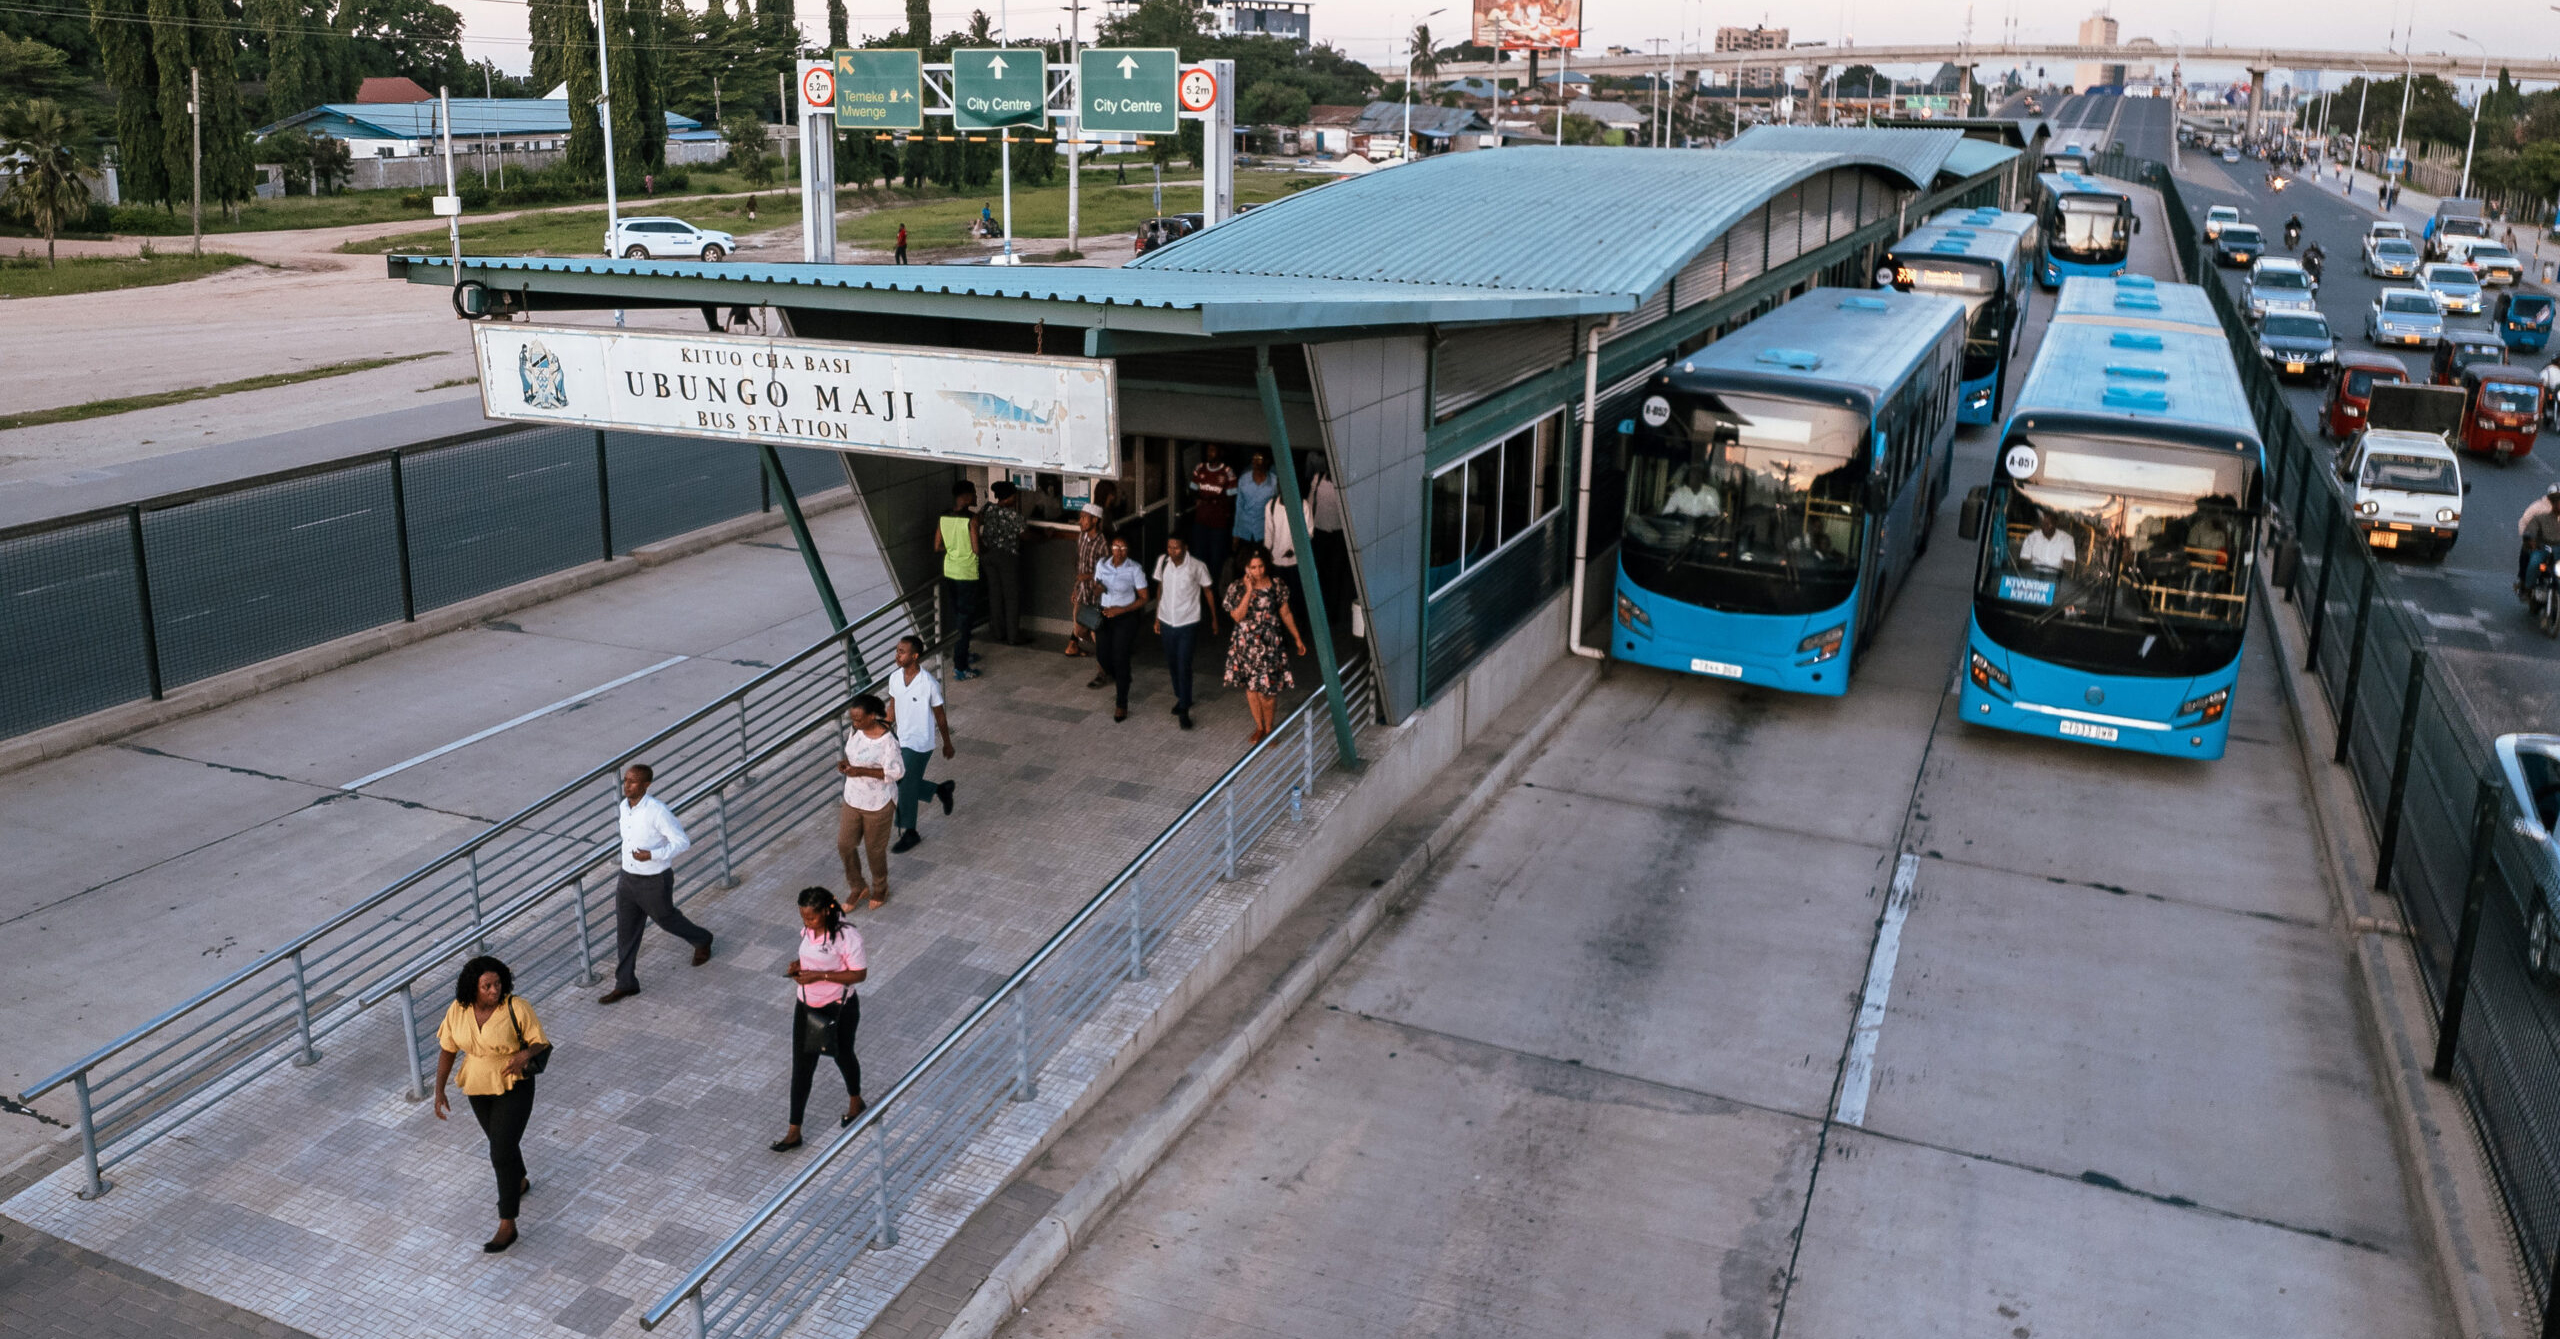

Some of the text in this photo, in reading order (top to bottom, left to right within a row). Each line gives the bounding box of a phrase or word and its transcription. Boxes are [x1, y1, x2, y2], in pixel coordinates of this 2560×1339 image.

[808, 82, 829, 92] 5.2m
[1186, 85, 1210, 95] 5.2m
[843, 90, 885, 103] Temeke
[841, 105, 887, 121] Mwenge
[966, 97, 1032, 113] City Centre
[1093, 98, 1162, 115] City Centre
[681, 347, 851, 374] KITUO CHA BASI
[624, 370, 916, 422] UBUNGO MAJI
[697, 410, 848, 440] BUS STATION
[2009, 455, 2034, 469] A-051
